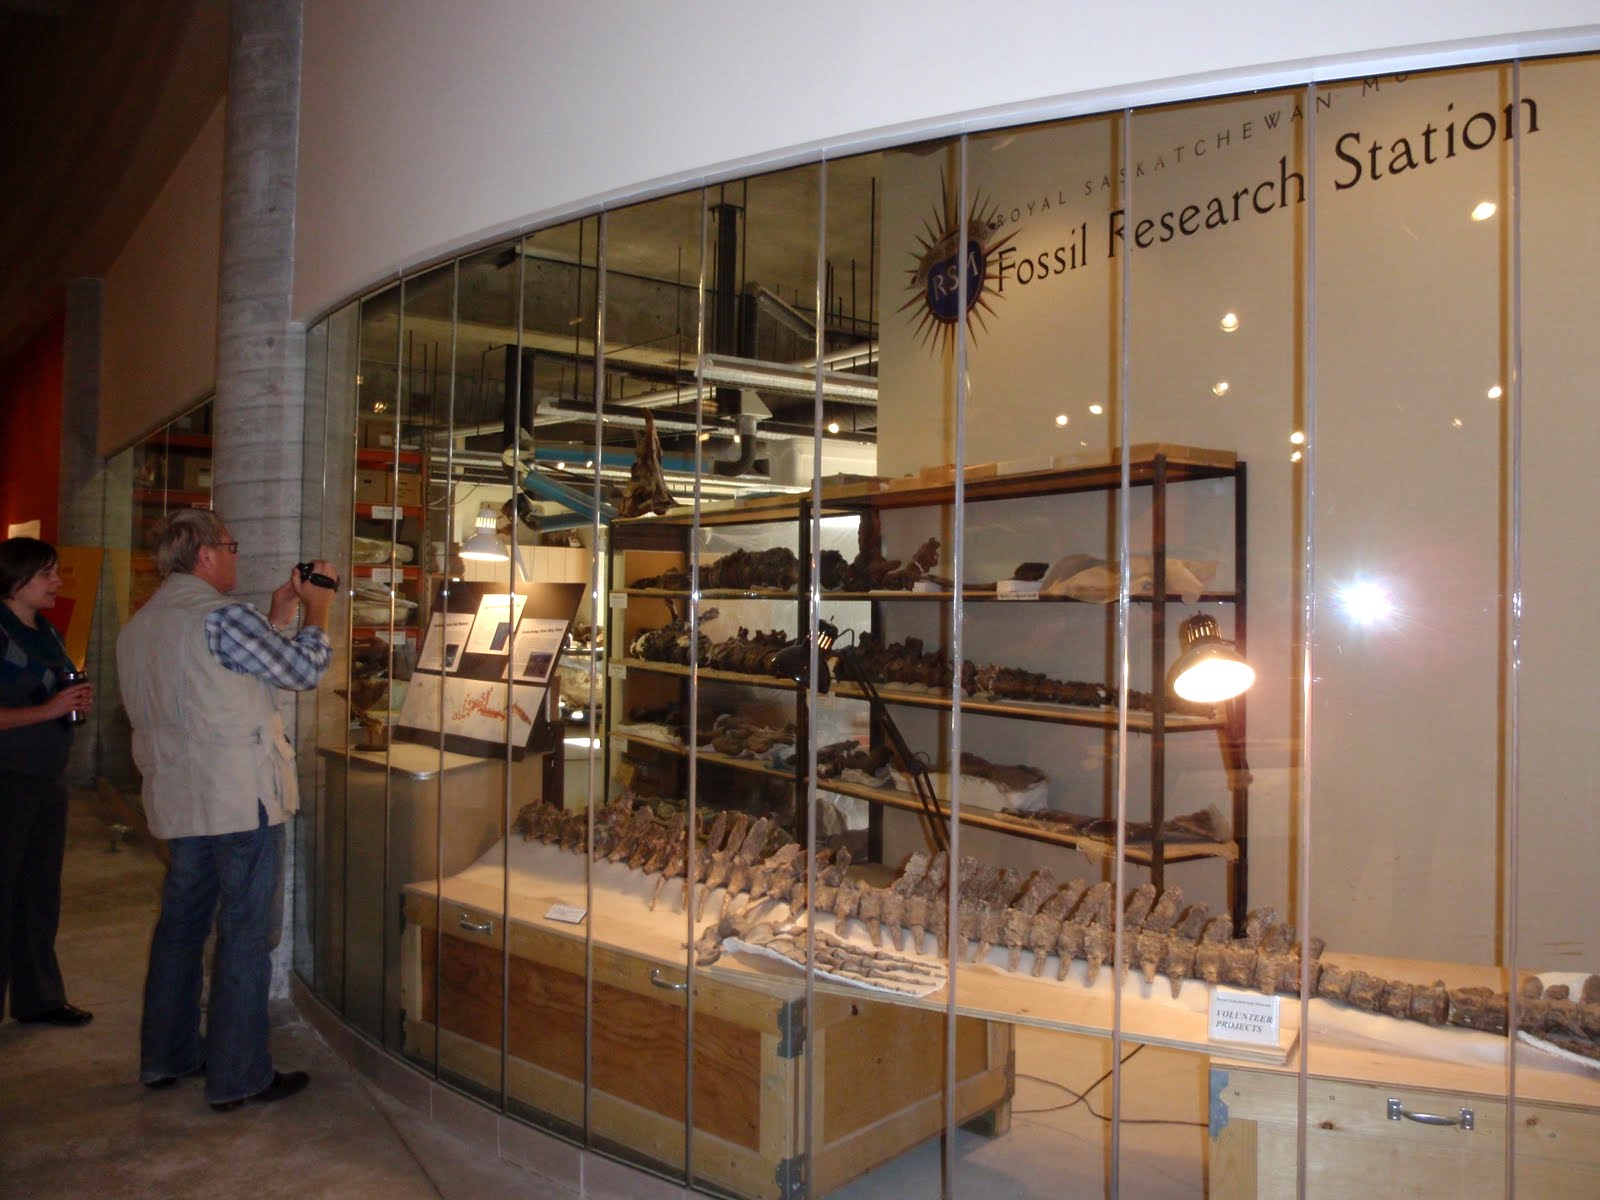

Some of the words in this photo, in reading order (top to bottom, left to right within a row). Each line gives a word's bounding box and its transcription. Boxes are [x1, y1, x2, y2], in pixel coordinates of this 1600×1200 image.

[1085, 92, 1332, 197] SASKATCHEWAN
[998, 222, 1088, 293] Fossil
[1107, 155, 1306, 259] Research
[1334, 98, 1541, 191] Station
[1215, 1020, 1263, 1033] PROJECTS
[1216, 1009, 1273, 1023] VOLUNTEER
